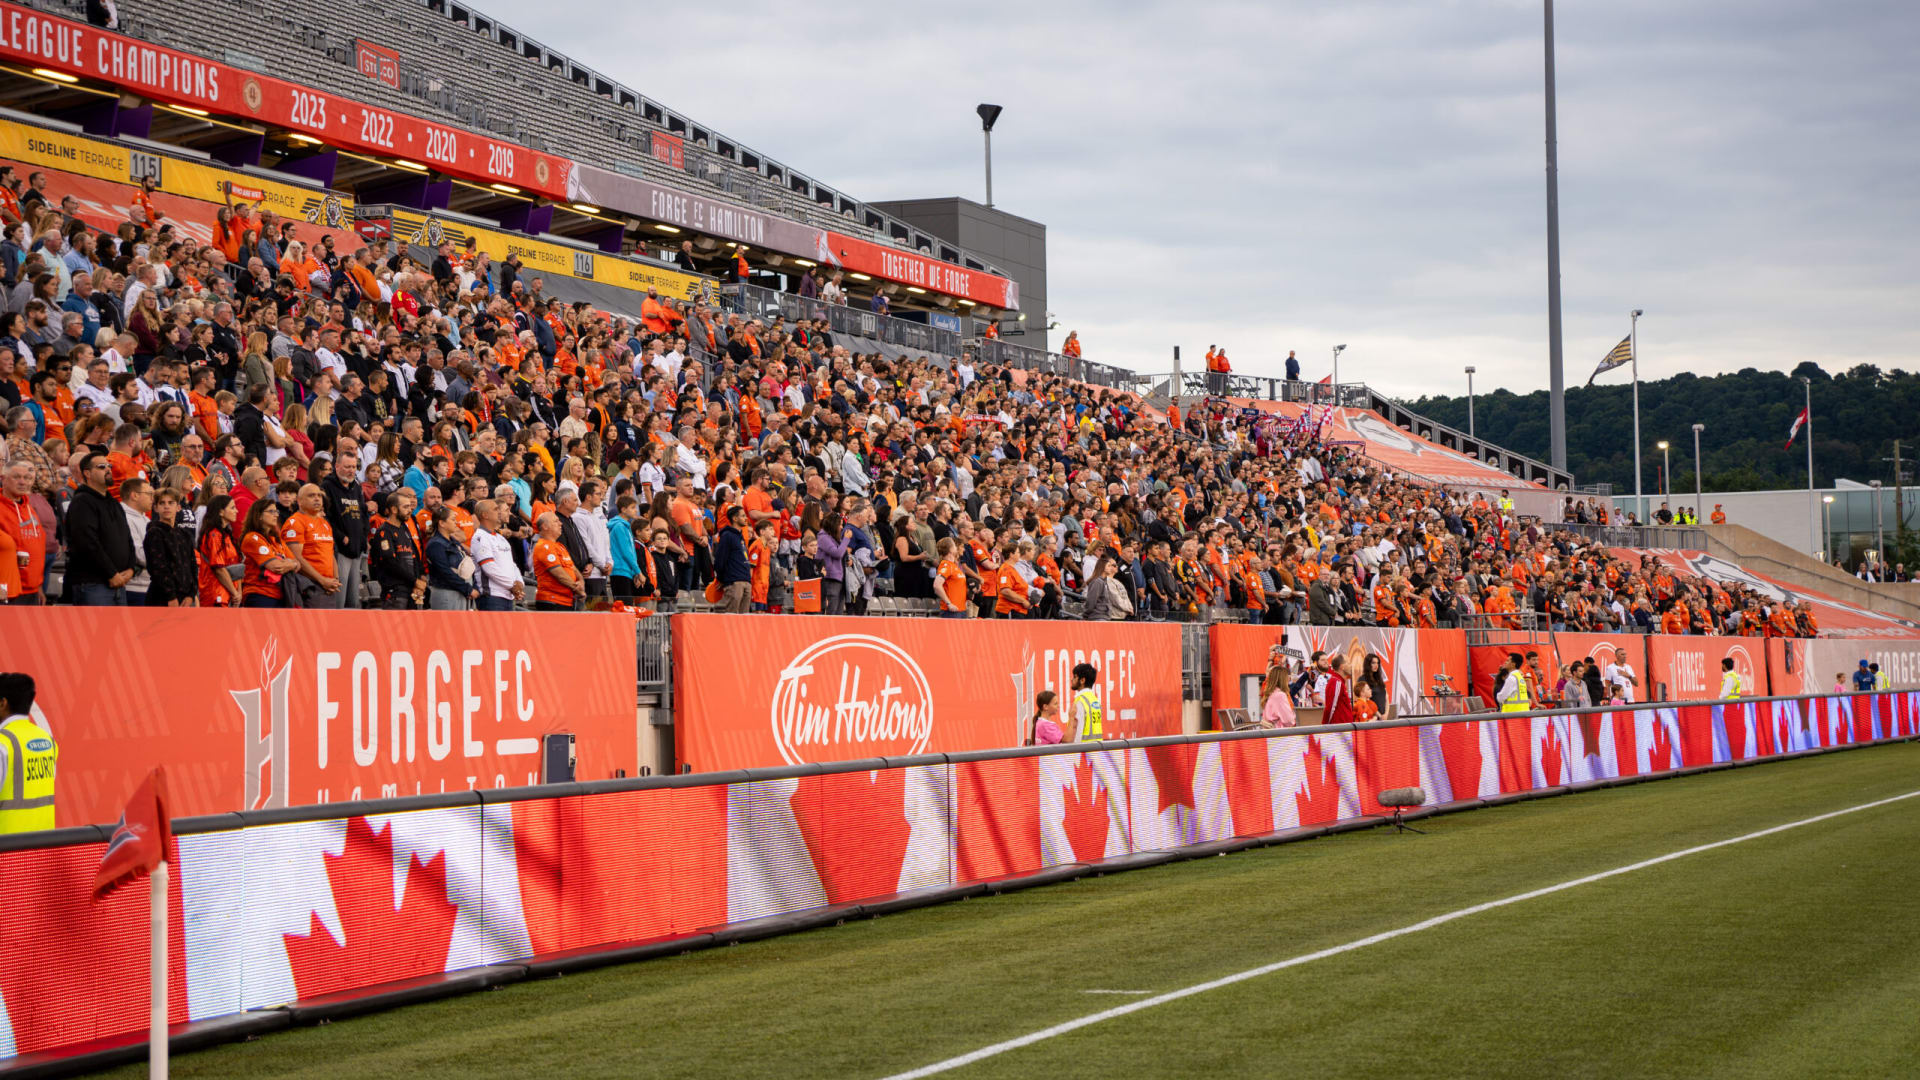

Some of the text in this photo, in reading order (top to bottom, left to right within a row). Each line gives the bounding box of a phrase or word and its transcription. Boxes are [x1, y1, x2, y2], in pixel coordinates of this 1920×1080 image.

[0, 8, 218, 101] LEAGUE CHAMPIONS
[291, 90, 514, 178] 2023 2022 2020 2019
[28, 139, 124, 170] SIDELINE TERRACE
[132, 153, 156, 177] 115
[263, 190, 295, 208] ERRACE
[652, 190, 763, 244] FORGE FC HAMILTON
[508, 245, 565, 266] SIDELINE TERRACE
[575, 253, 590, 272] 116
[881, 251, 970, 296] TOGETHER WE FORGE
[629, 271, 680, 290] SIDELINE TERRACE
[863, 314, 875, 331] 117
[1044, 648, 1136, 724] FOGE FC
[1677, 651, 1699, 692] FORGE
[317, 649, 535, 769] FORGE FC
[780, 660, 927, 748] Tim Hortons
[26, 756, 54, 781] SECURIT
